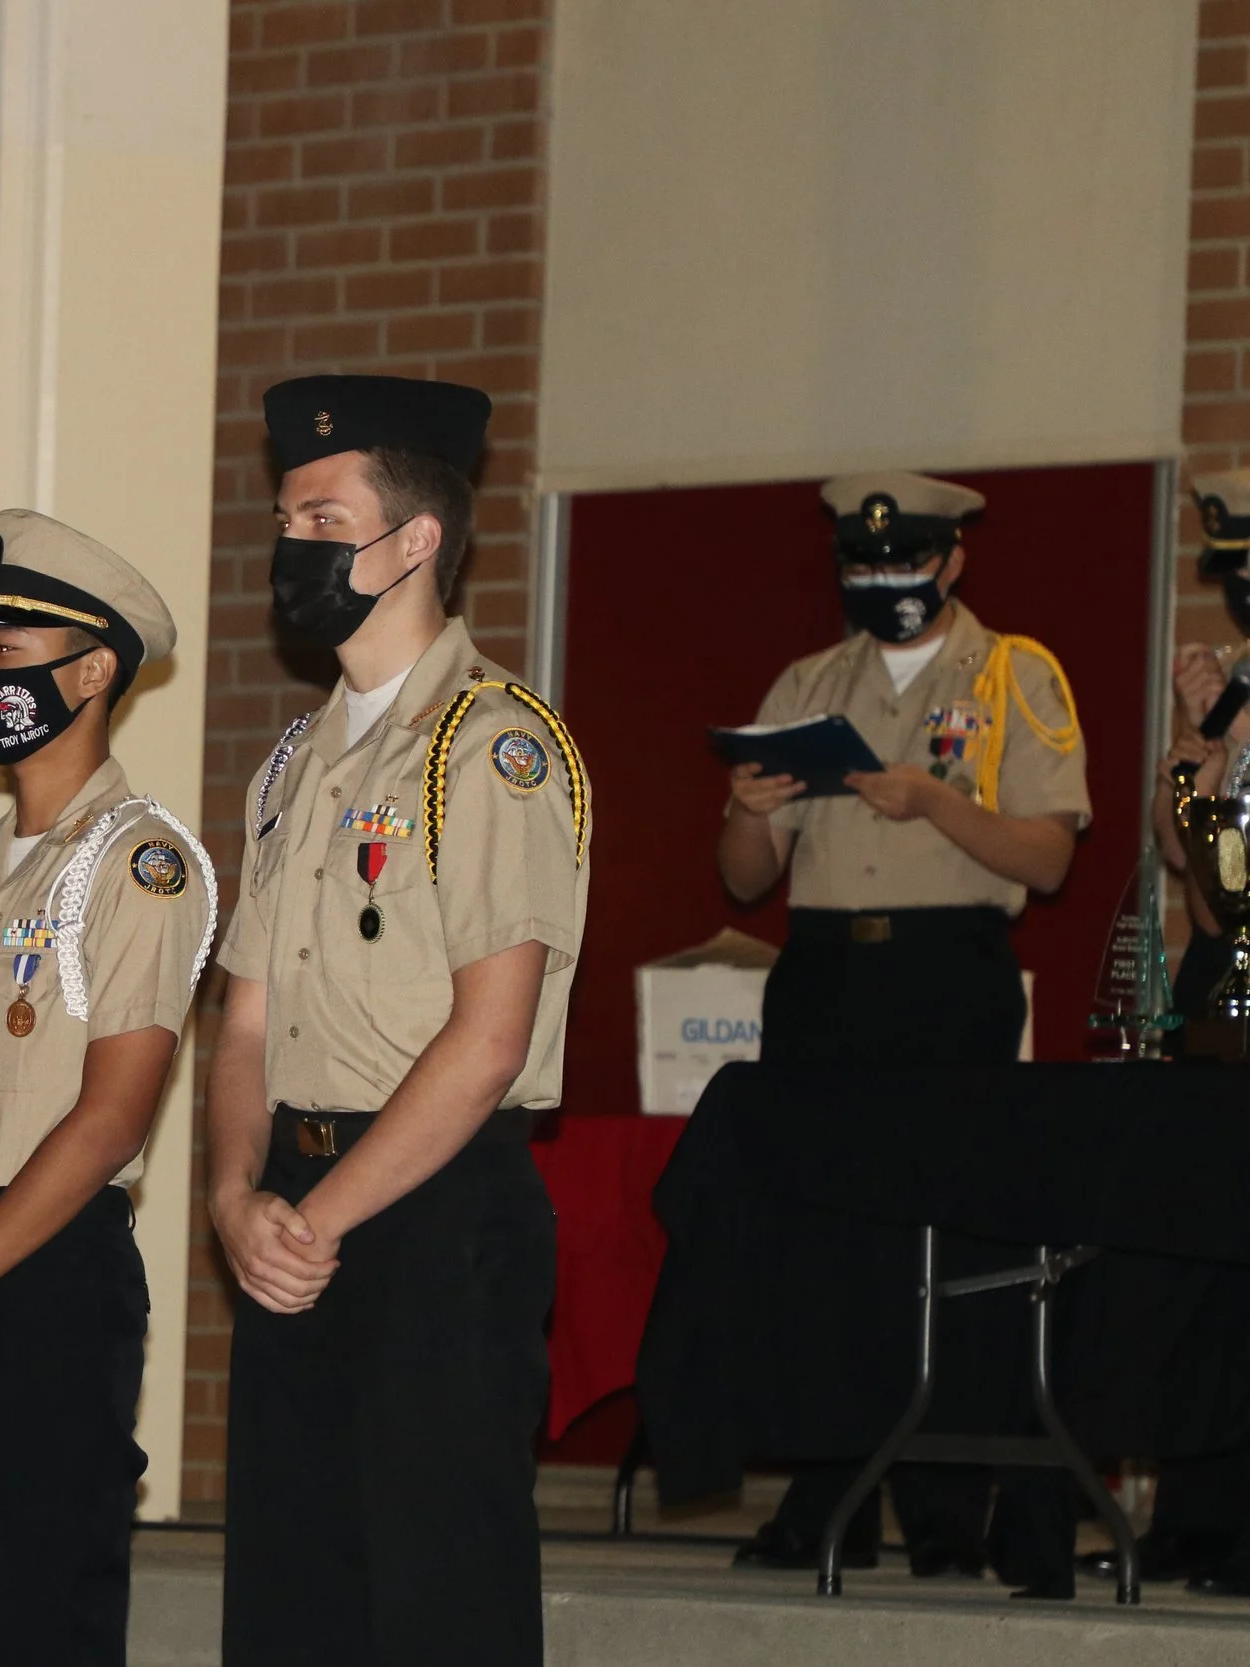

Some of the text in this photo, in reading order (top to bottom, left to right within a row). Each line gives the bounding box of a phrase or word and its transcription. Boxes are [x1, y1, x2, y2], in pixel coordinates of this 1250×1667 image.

[0, 724, 50, 749] TROY NJROTC
[507, 731, 532, 741] NAVY
[505, 775, 537, 787] JROTC
[148, 841, 174, 850] NAVY
[144, 884, 177, 894] JROTC
